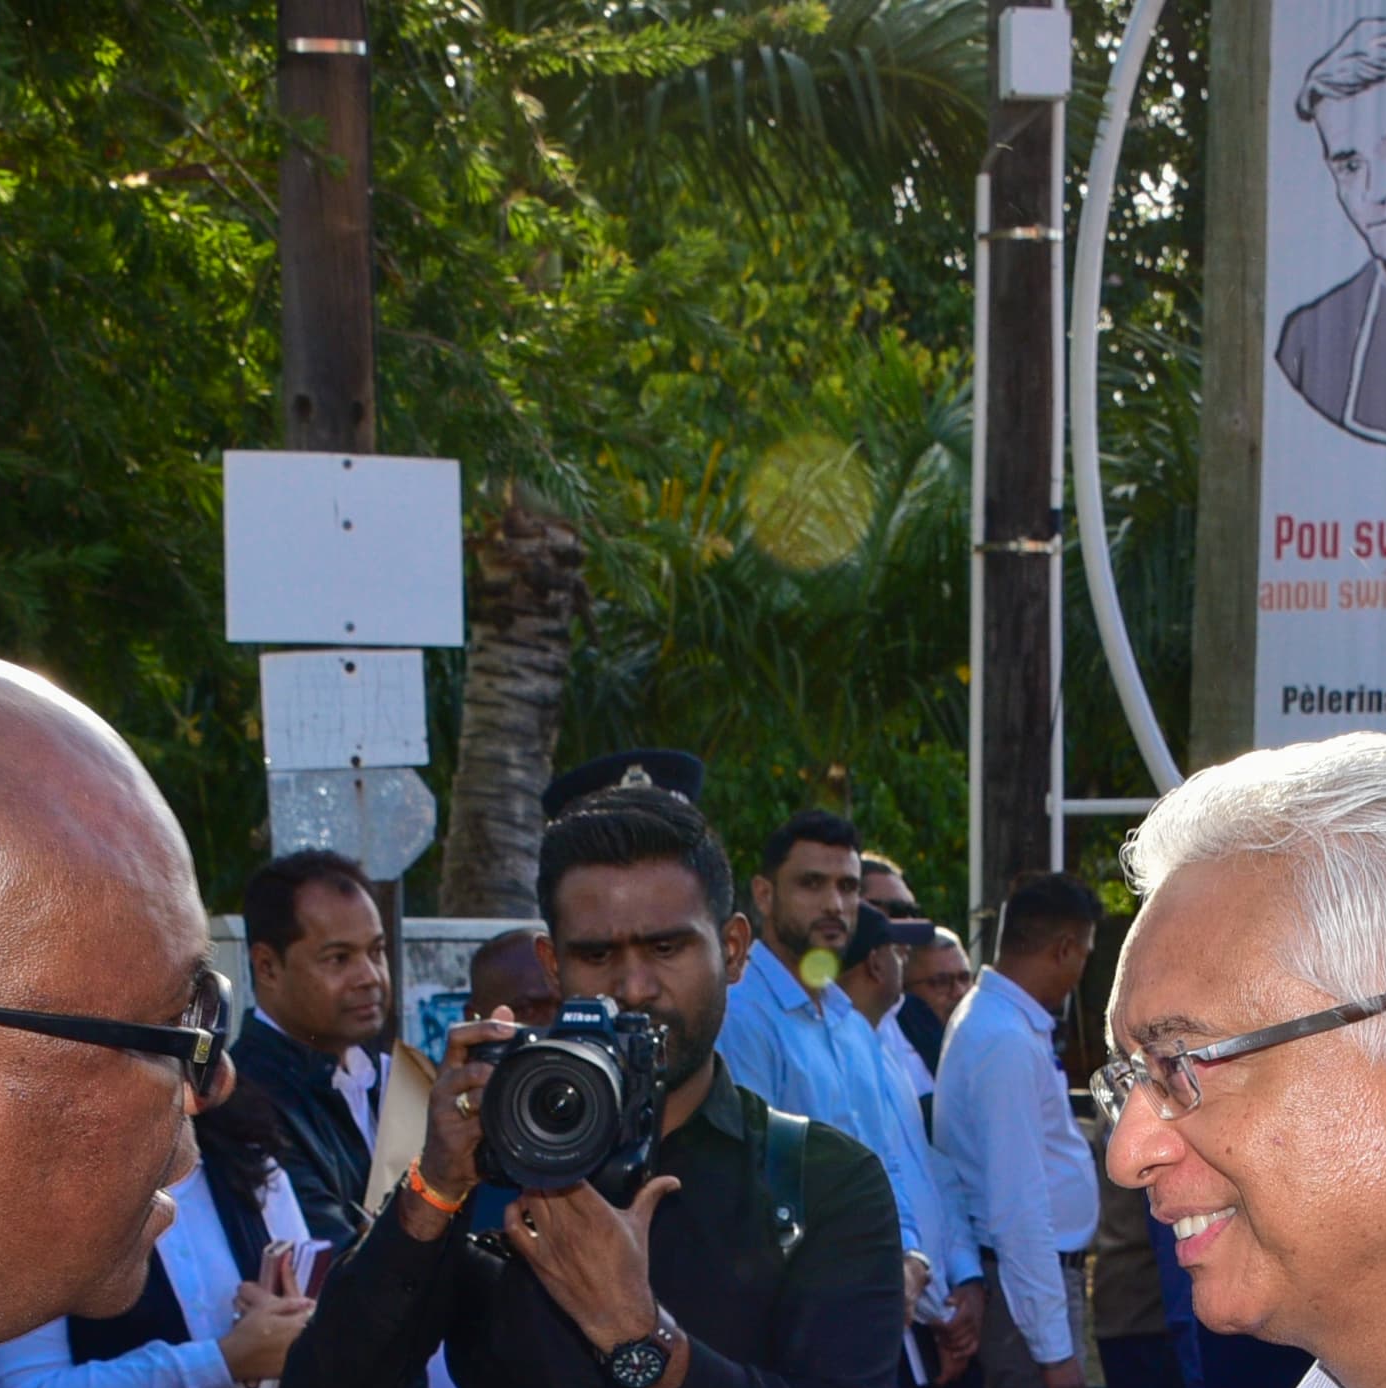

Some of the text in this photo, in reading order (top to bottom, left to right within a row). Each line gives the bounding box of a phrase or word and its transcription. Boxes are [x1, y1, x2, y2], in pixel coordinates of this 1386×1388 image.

[1274, 514, 1340, 560] Pou
[1258, 579, 1328, 612] anou
[563, 1011, 601, 1023] Nikon
